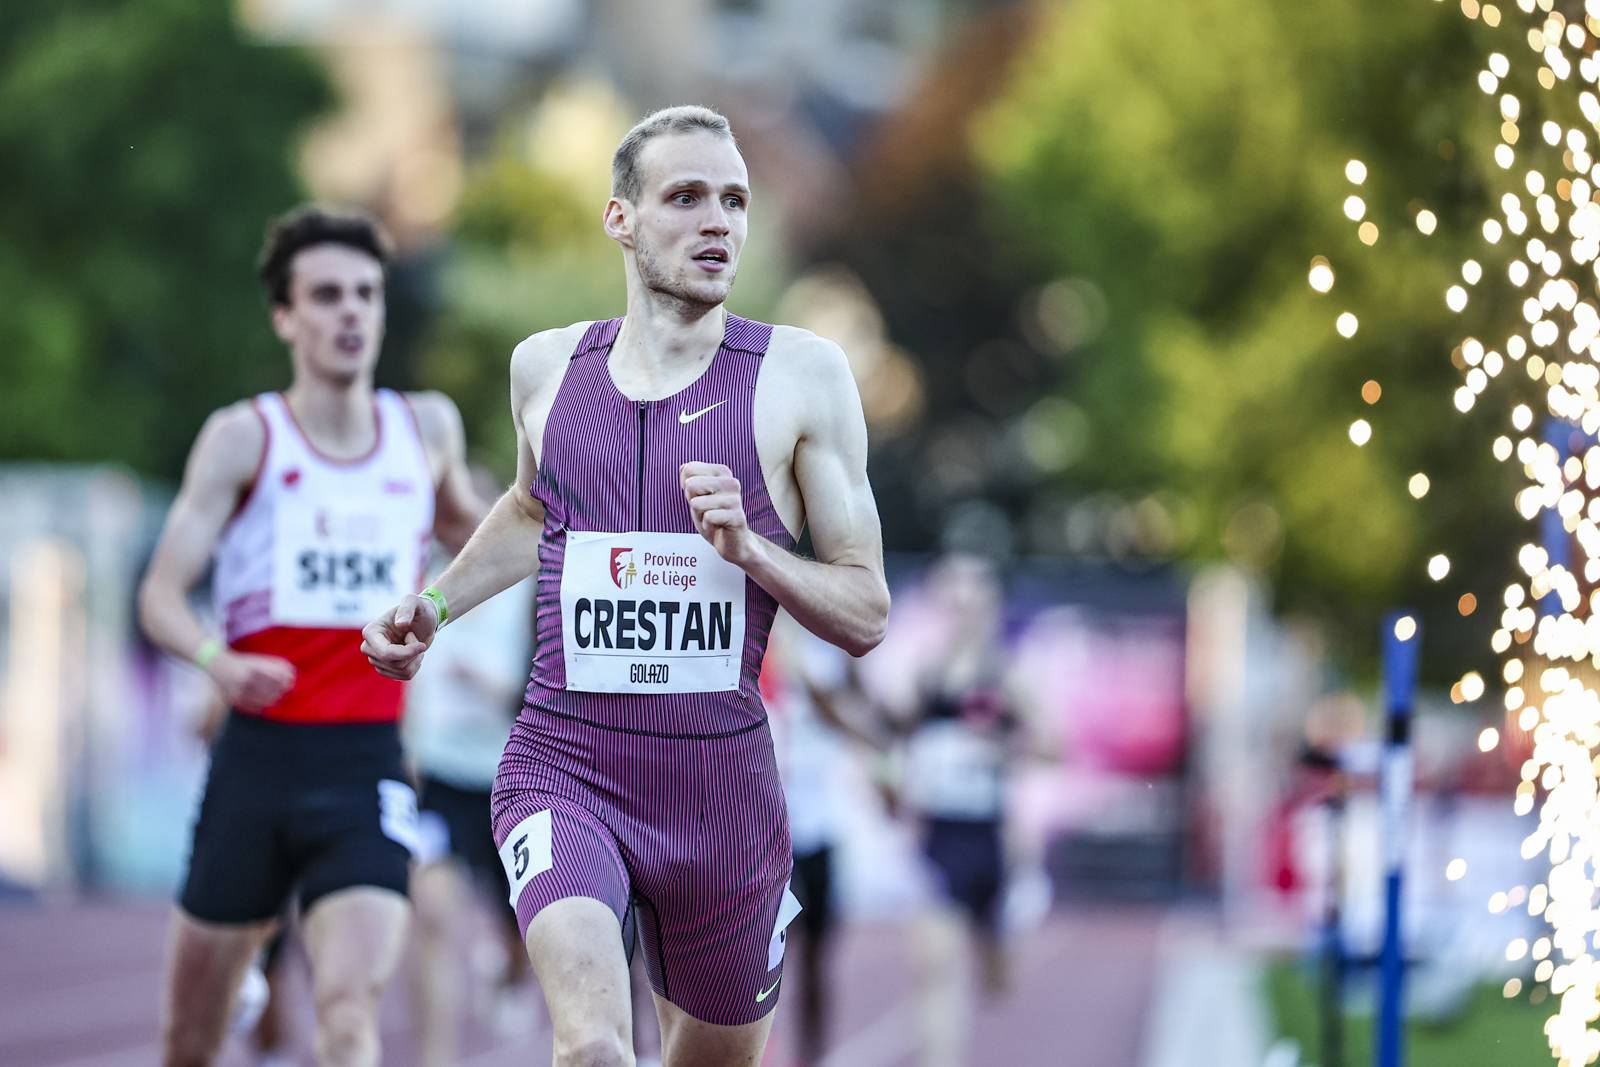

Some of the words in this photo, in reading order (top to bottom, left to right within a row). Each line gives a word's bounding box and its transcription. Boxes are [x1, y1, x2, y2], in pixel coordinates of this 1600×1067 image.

[297, 550, 395, 591] SISK
[644, 552, 697, 568] Province
[643, 570, 659, 585] de
[663, 570, 697, 592] Liège
[575, 598, 731, 651] CRESTAN
[630, 663, 668, 684] GOLAZO
[513, 834, 530, 880] 5
